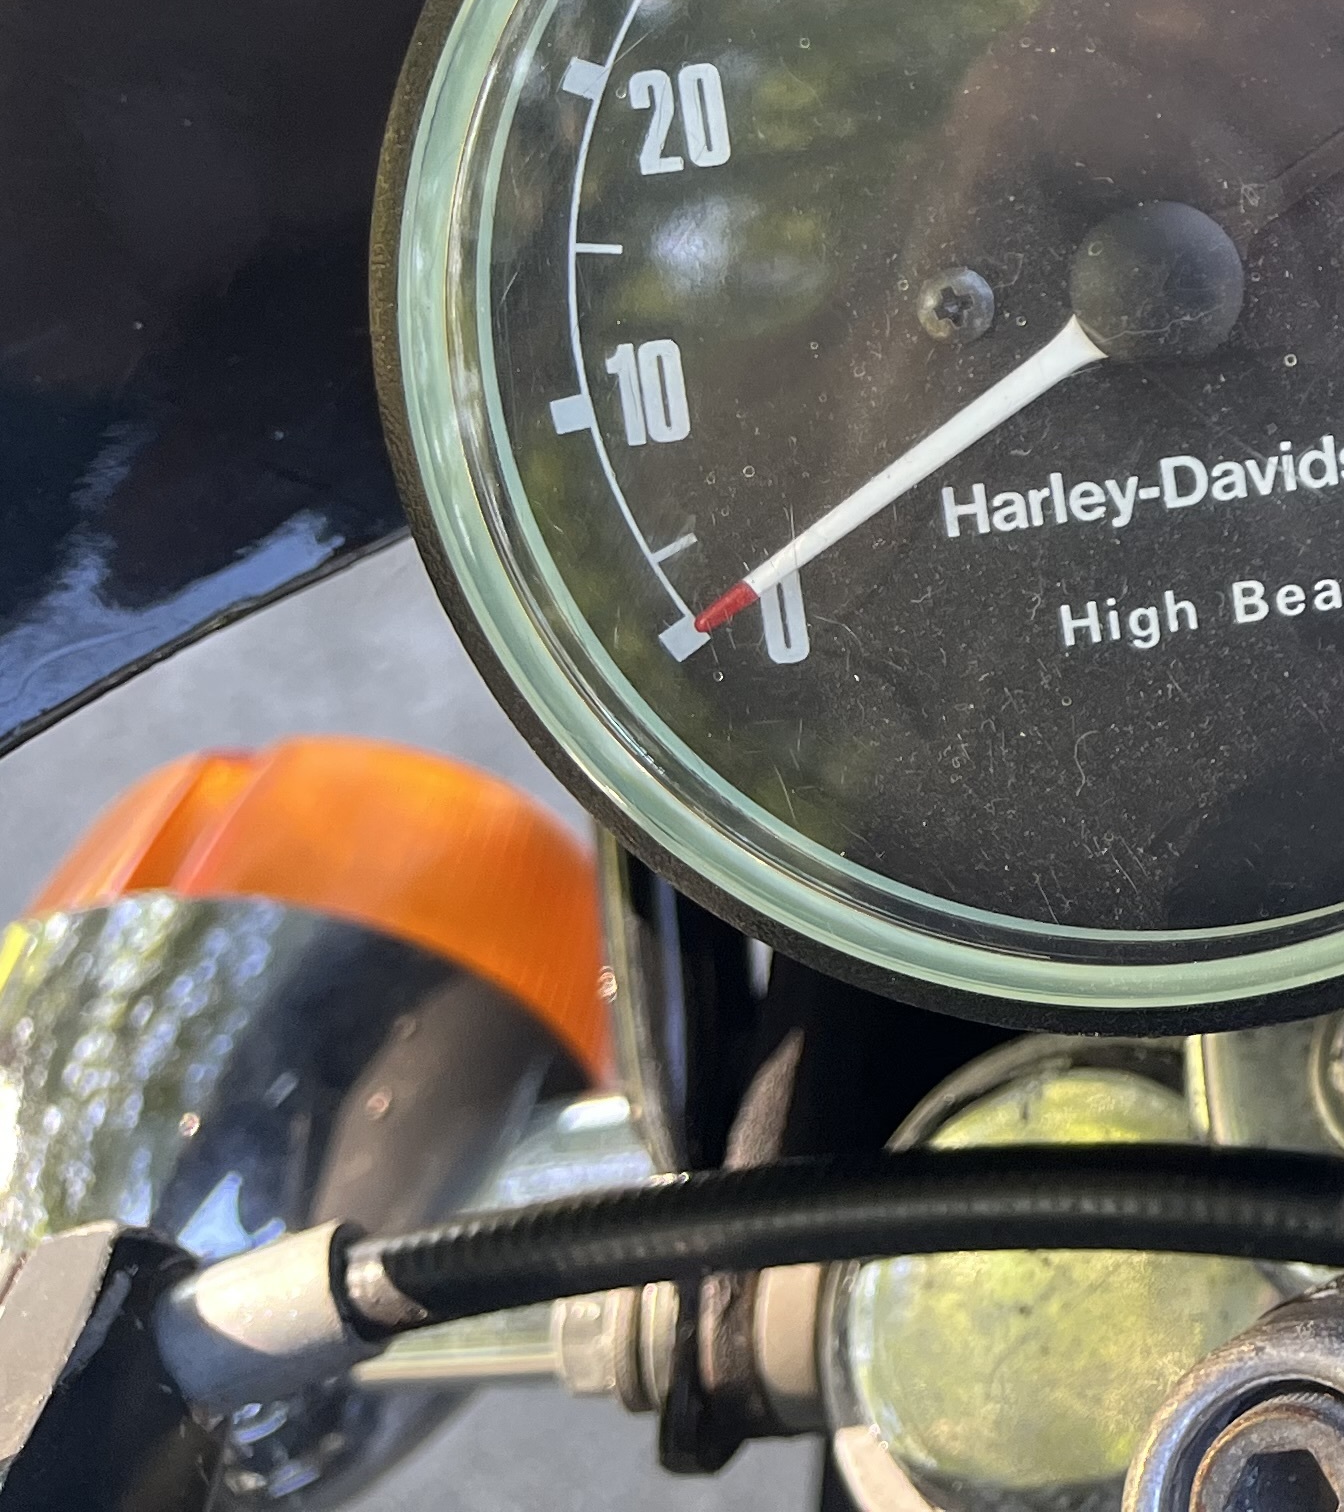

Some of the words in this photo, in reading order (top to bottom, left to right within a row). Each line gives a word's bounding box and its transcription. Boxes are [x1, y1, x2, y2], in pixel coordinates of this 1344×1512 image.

[628, 62, 732, 176] 20
[605, 339, 691, 446] 10
[758, 565, 810, 665] 0
[1059, 591, 1198, 649] High
